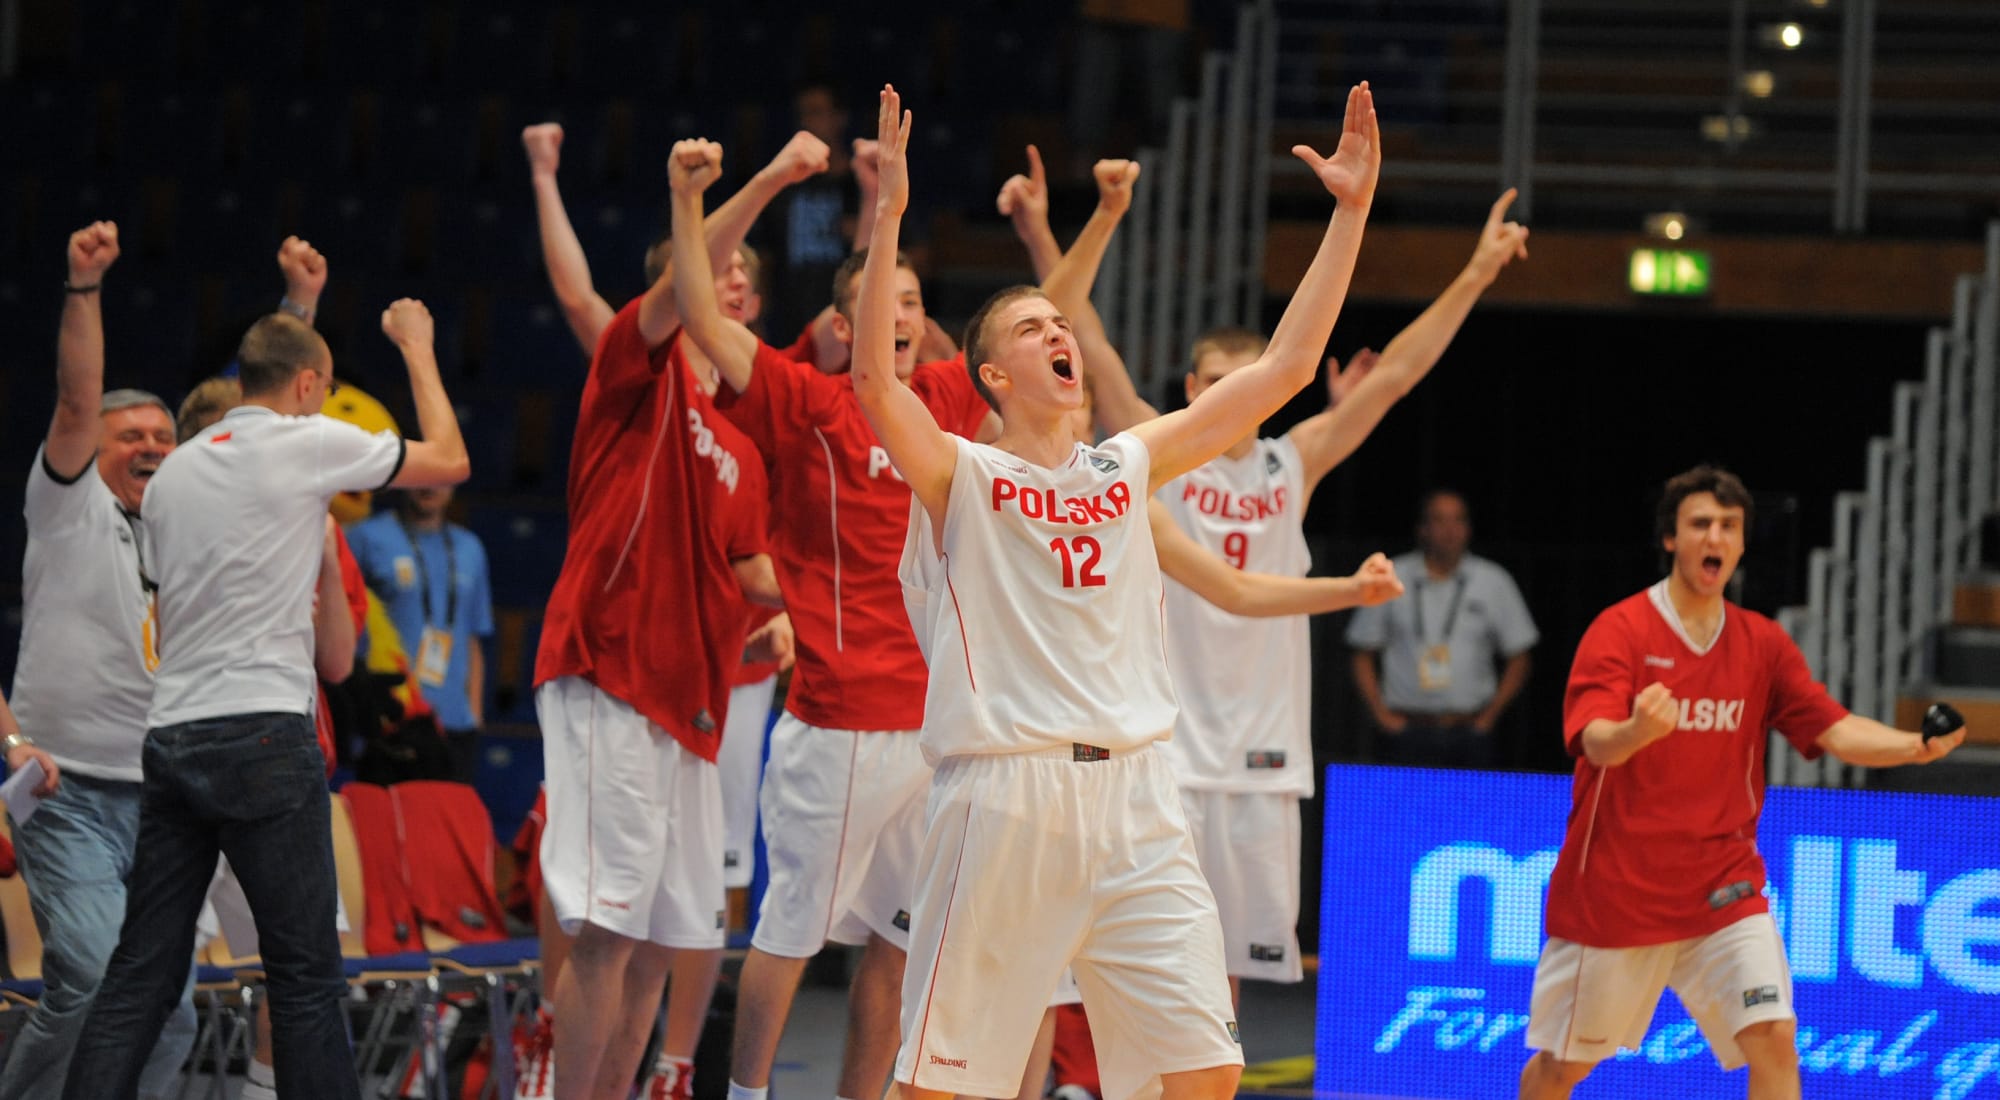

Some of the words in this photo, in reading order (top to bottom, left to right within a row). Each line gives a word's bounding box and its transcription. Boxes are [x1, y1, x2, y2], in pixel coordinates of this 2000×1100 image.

[992, 477, 1130, 525] POLSKA
[1183, 481, 1287, 521] POLSKA
[1049, 535, 1106, 588] 12
[1223, 531, 1249, 570] 9
[1407, 834, 2000, 994] mlte
[1373, 985, 1530, 1052] For
[929, 1055, 967, 1070] SPALDING
